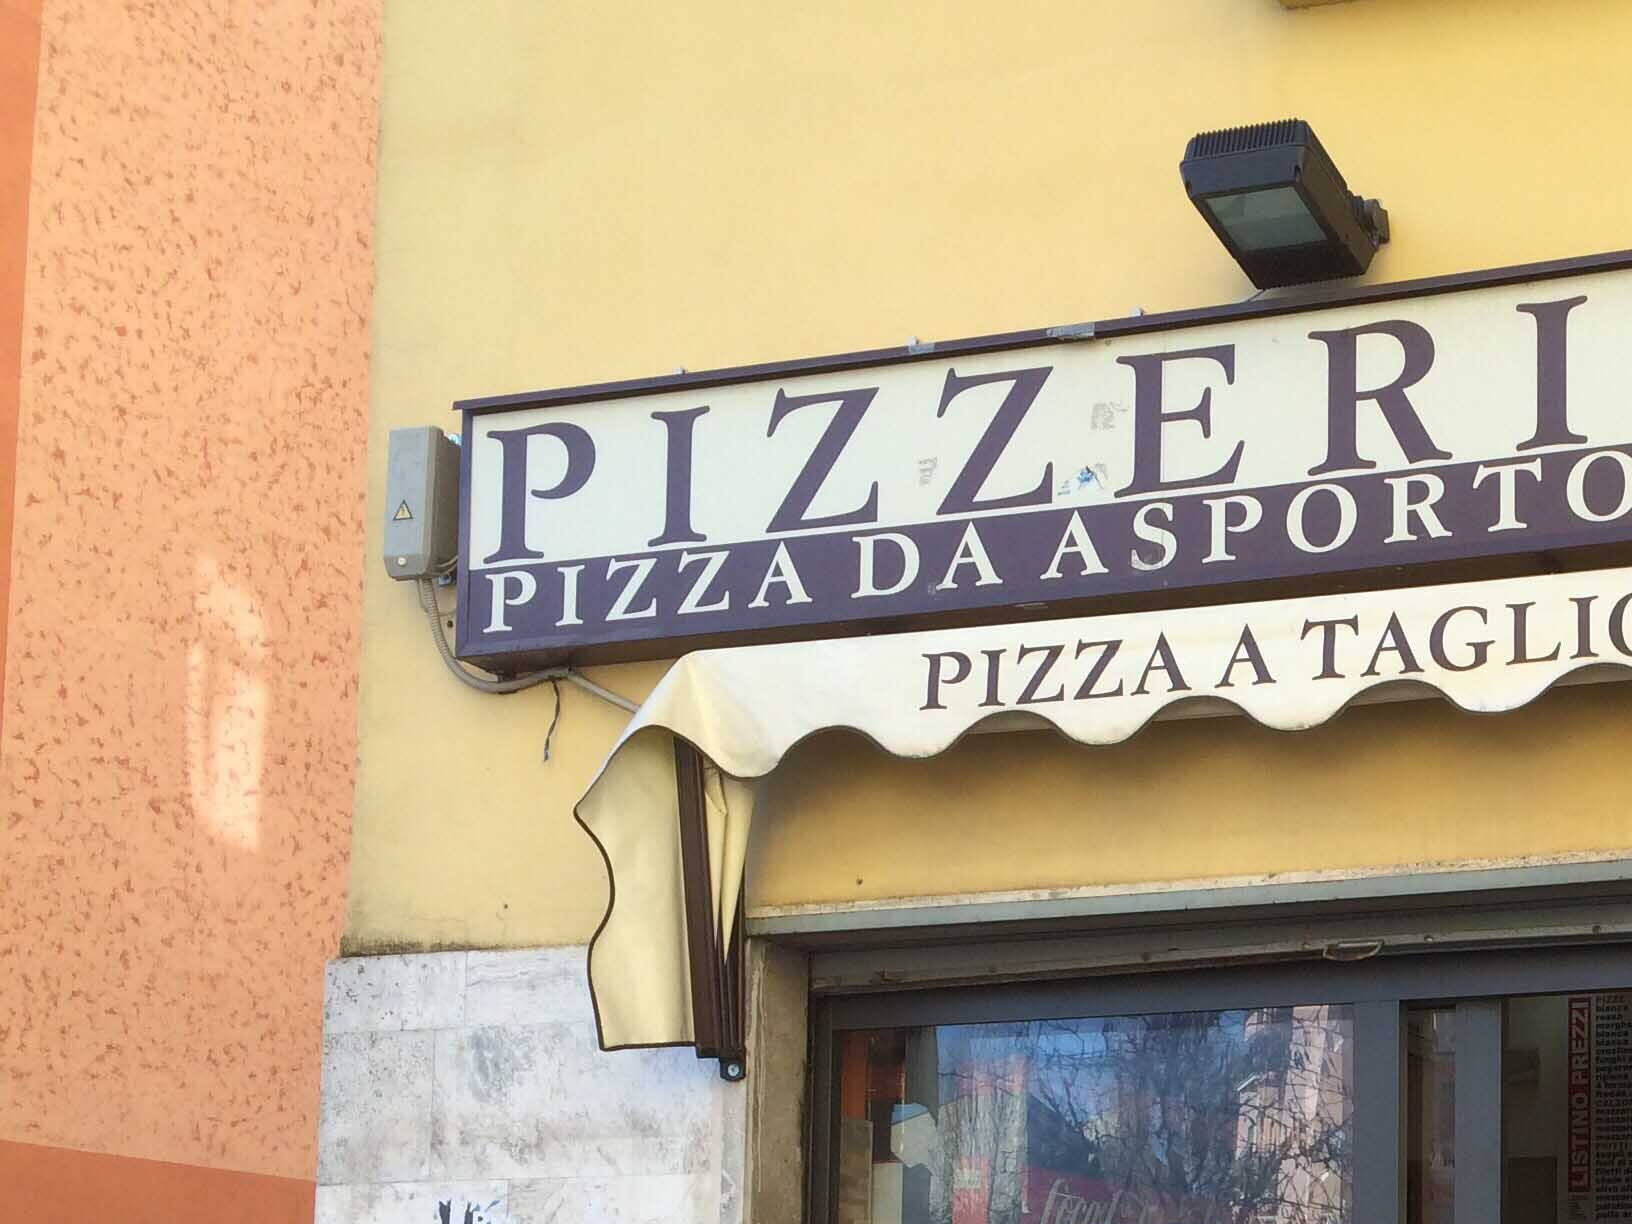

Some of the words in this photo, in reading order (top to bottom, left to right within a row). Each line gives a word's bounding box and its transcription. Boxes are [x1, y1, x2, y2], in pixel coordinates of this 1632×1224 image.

[483, 542, 812, 634] PIZZA
[851, 522, 1003, 600] DA
[919, 632, 1193, 711] PIZZA
[1216, 623, 1277, 688] A
[1571, 998, 1590, 1086] PREZZI
[1571, 1093, 1590, 1190] LISTINO
